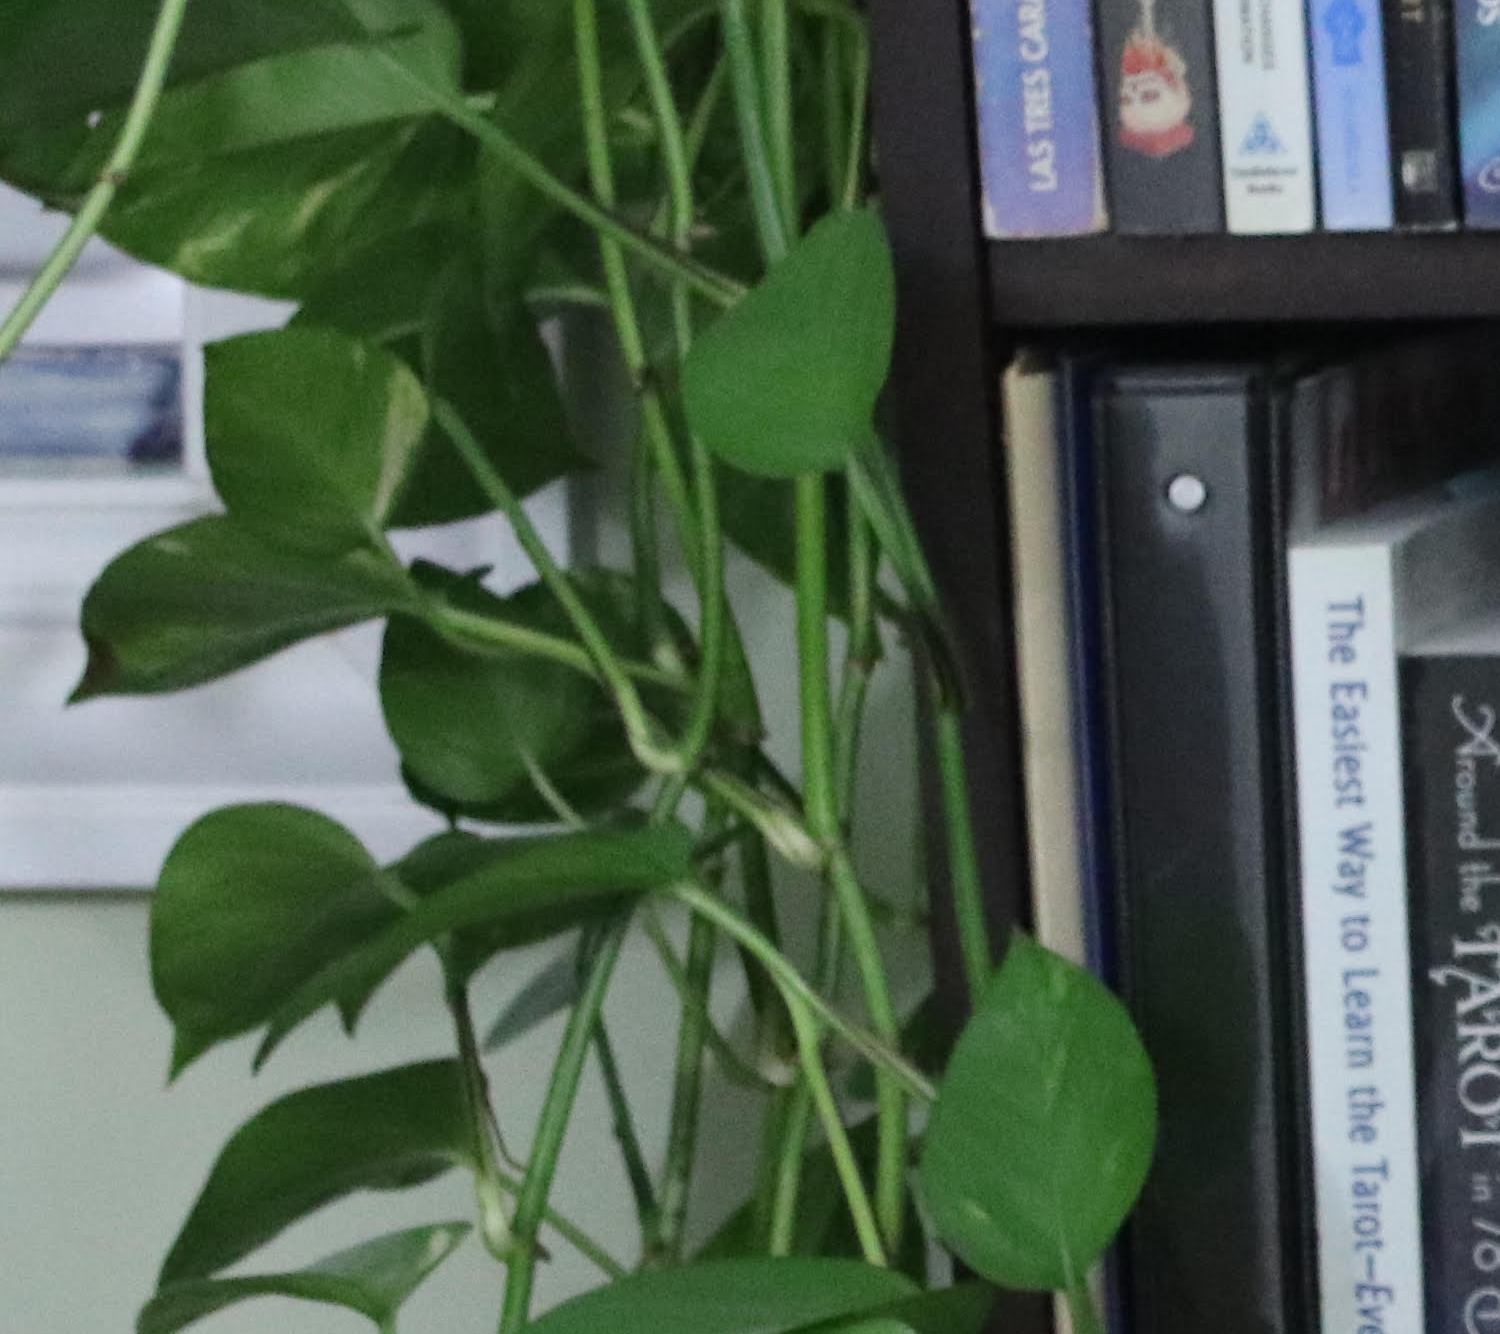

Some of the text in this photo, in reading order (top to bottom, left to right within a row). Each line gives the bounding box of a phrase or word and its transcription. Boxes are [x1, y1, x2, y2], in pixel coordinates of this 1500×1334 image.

[1020, 69, 1054, 134] TRES
[1027, 141, 1058, 191] LAS
[1326, 596, 1365, 664] The
[1329, 682, 1369, 810] Easiest
[1331, 822, 1373, 899] Way
[1340, 916, 1377, 952] to
[1342, 968, 1381, 1068] Learn
[1347, 1087, 1387, 1145] the
